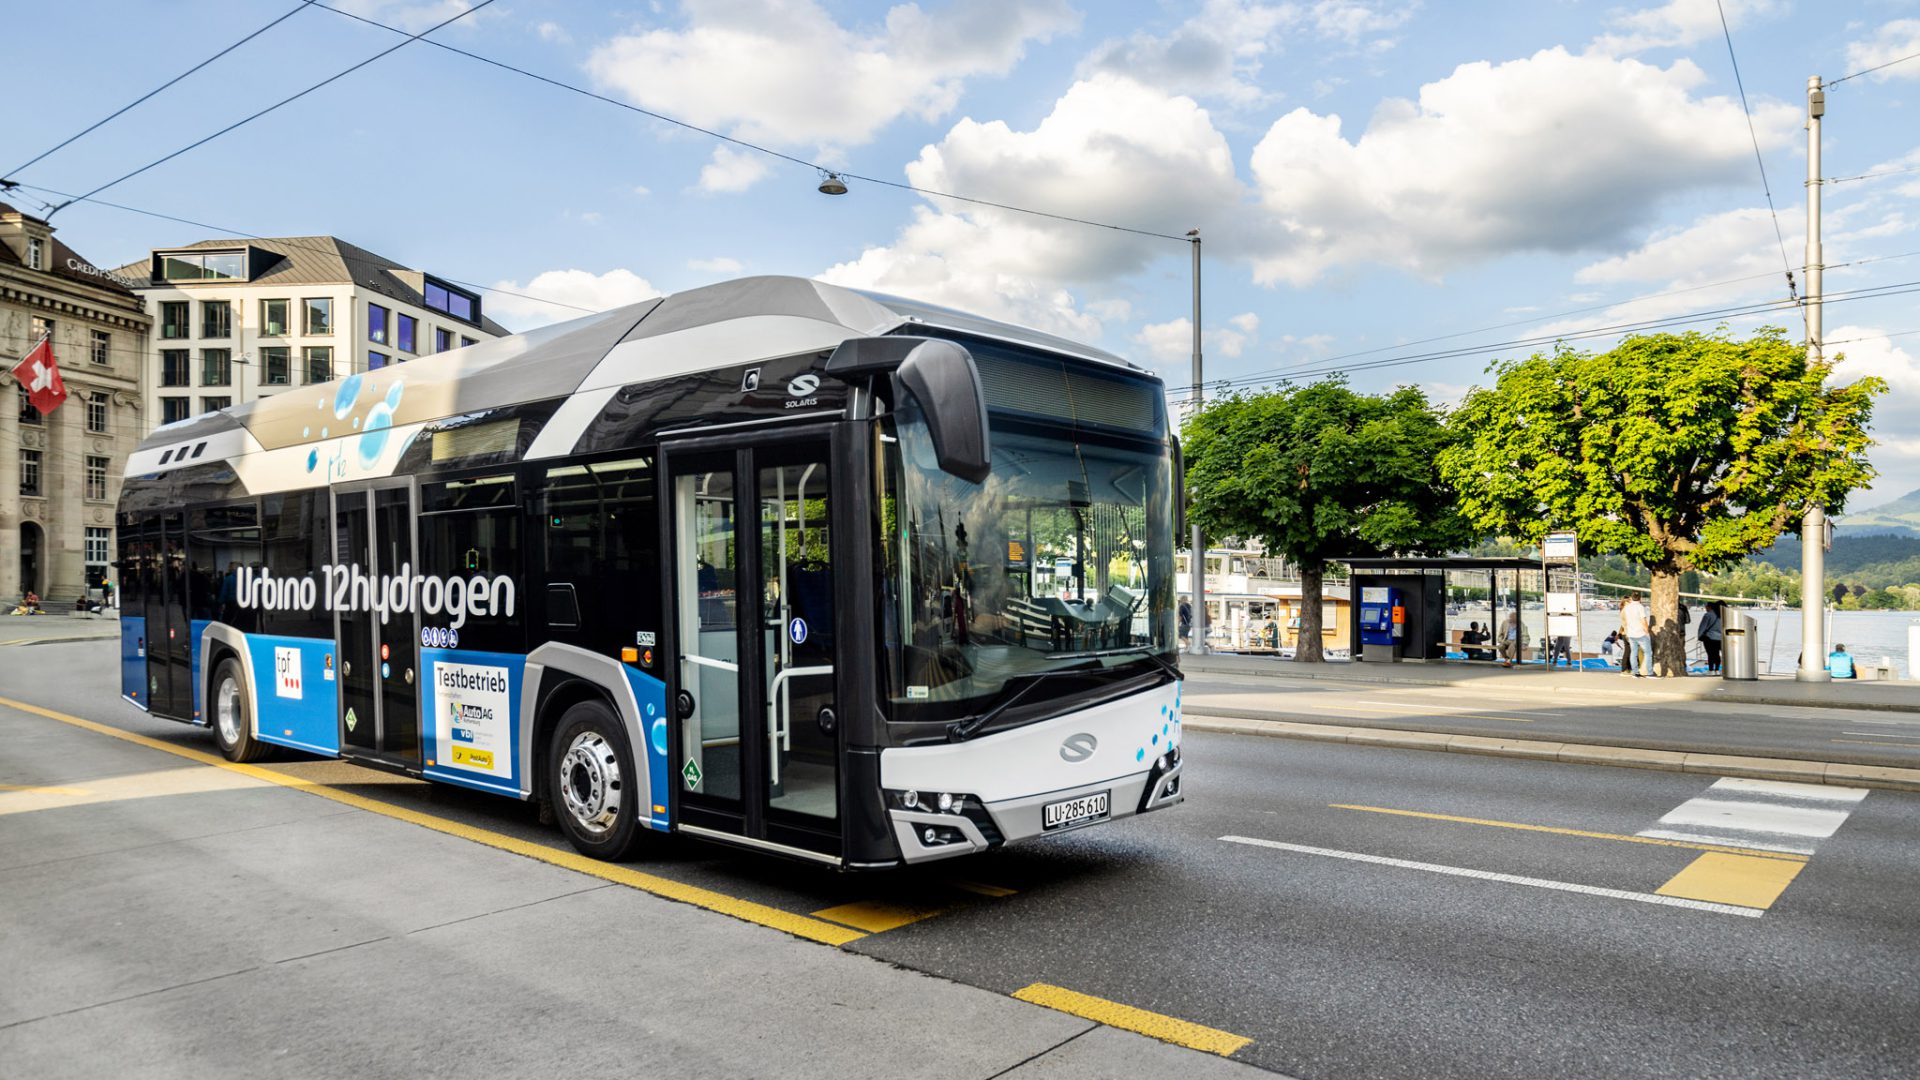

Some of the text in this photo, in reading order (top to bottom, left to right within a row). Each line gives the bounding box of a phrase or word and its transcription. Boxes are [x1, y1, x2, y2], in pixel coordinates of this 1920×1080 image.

[66, 258, 104, 277] CREDIT
[785, 397, 818, 409] SOLARIS
[236, 566, 317, 611] Urbino
[277, 651, 291, 679] tpf
[437, 667, 506, 693] Testbetrieb
[482, 708, 493, 720] AG
